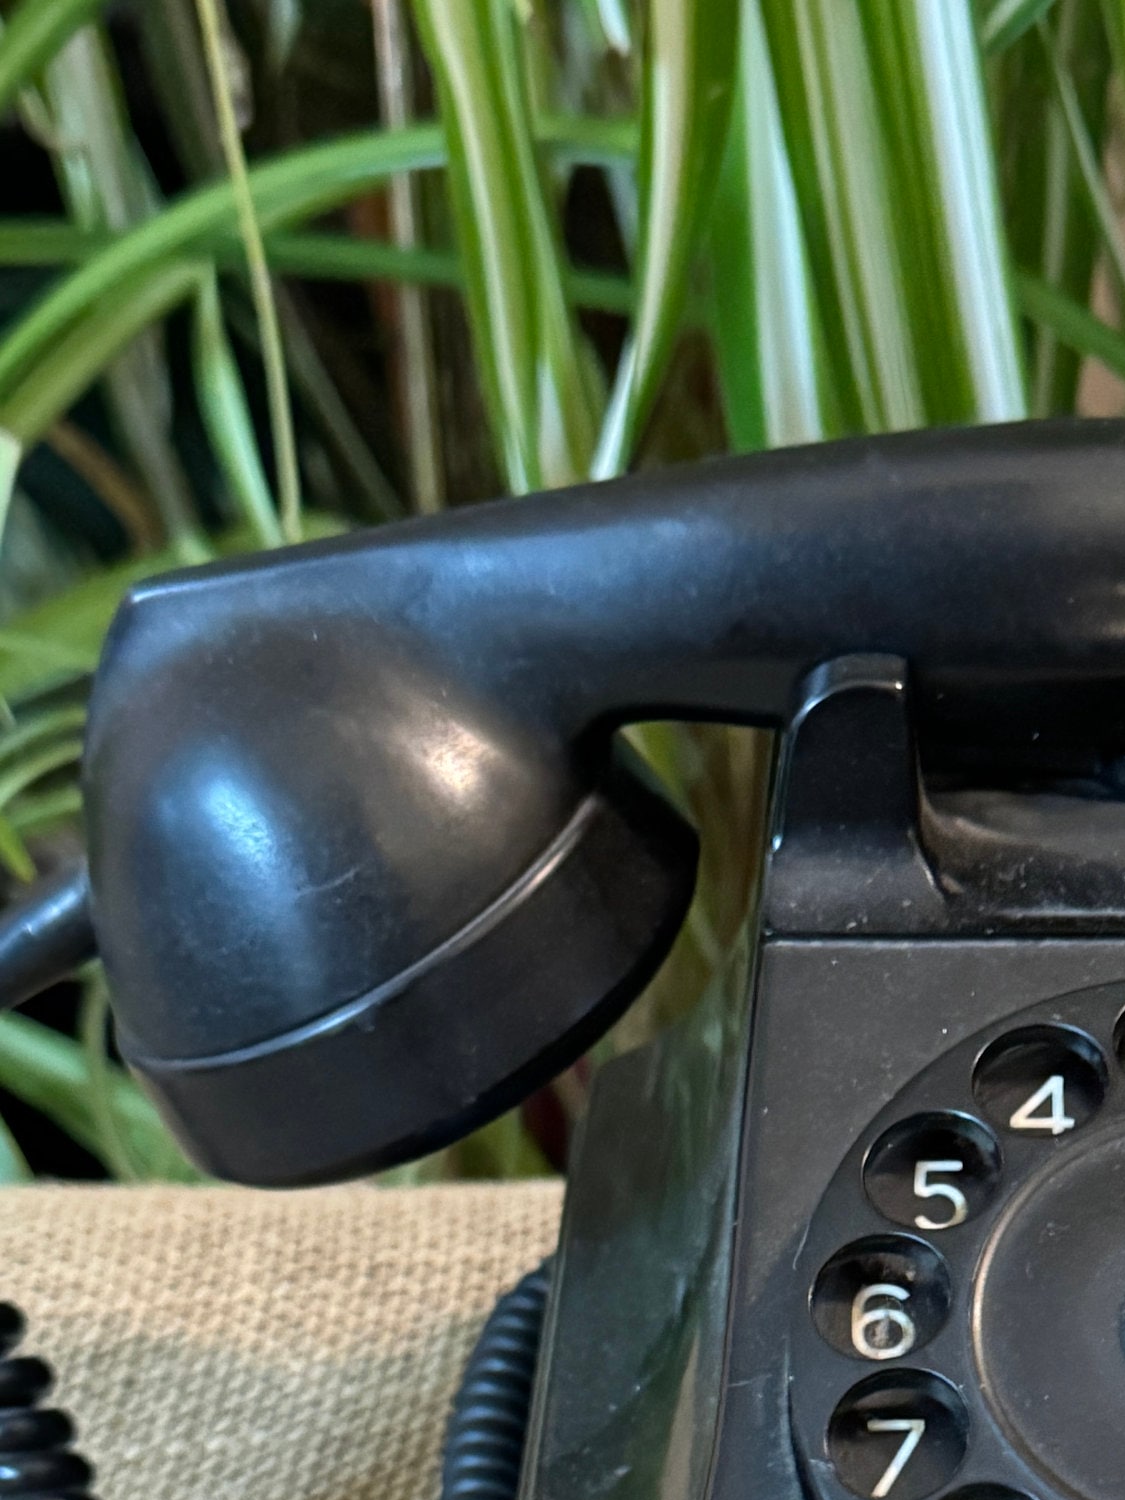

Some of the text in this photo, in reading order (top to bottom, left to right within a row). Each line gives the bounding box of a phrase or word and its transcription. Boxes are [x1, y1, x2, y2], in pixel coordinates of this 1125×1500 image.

[1009, 1075, 1075, 1135] 4
[913, 1160, 968, 1230] 5
[851, 1283, 915, 1360] 6
[867, 1418, 925, 1498] 7
